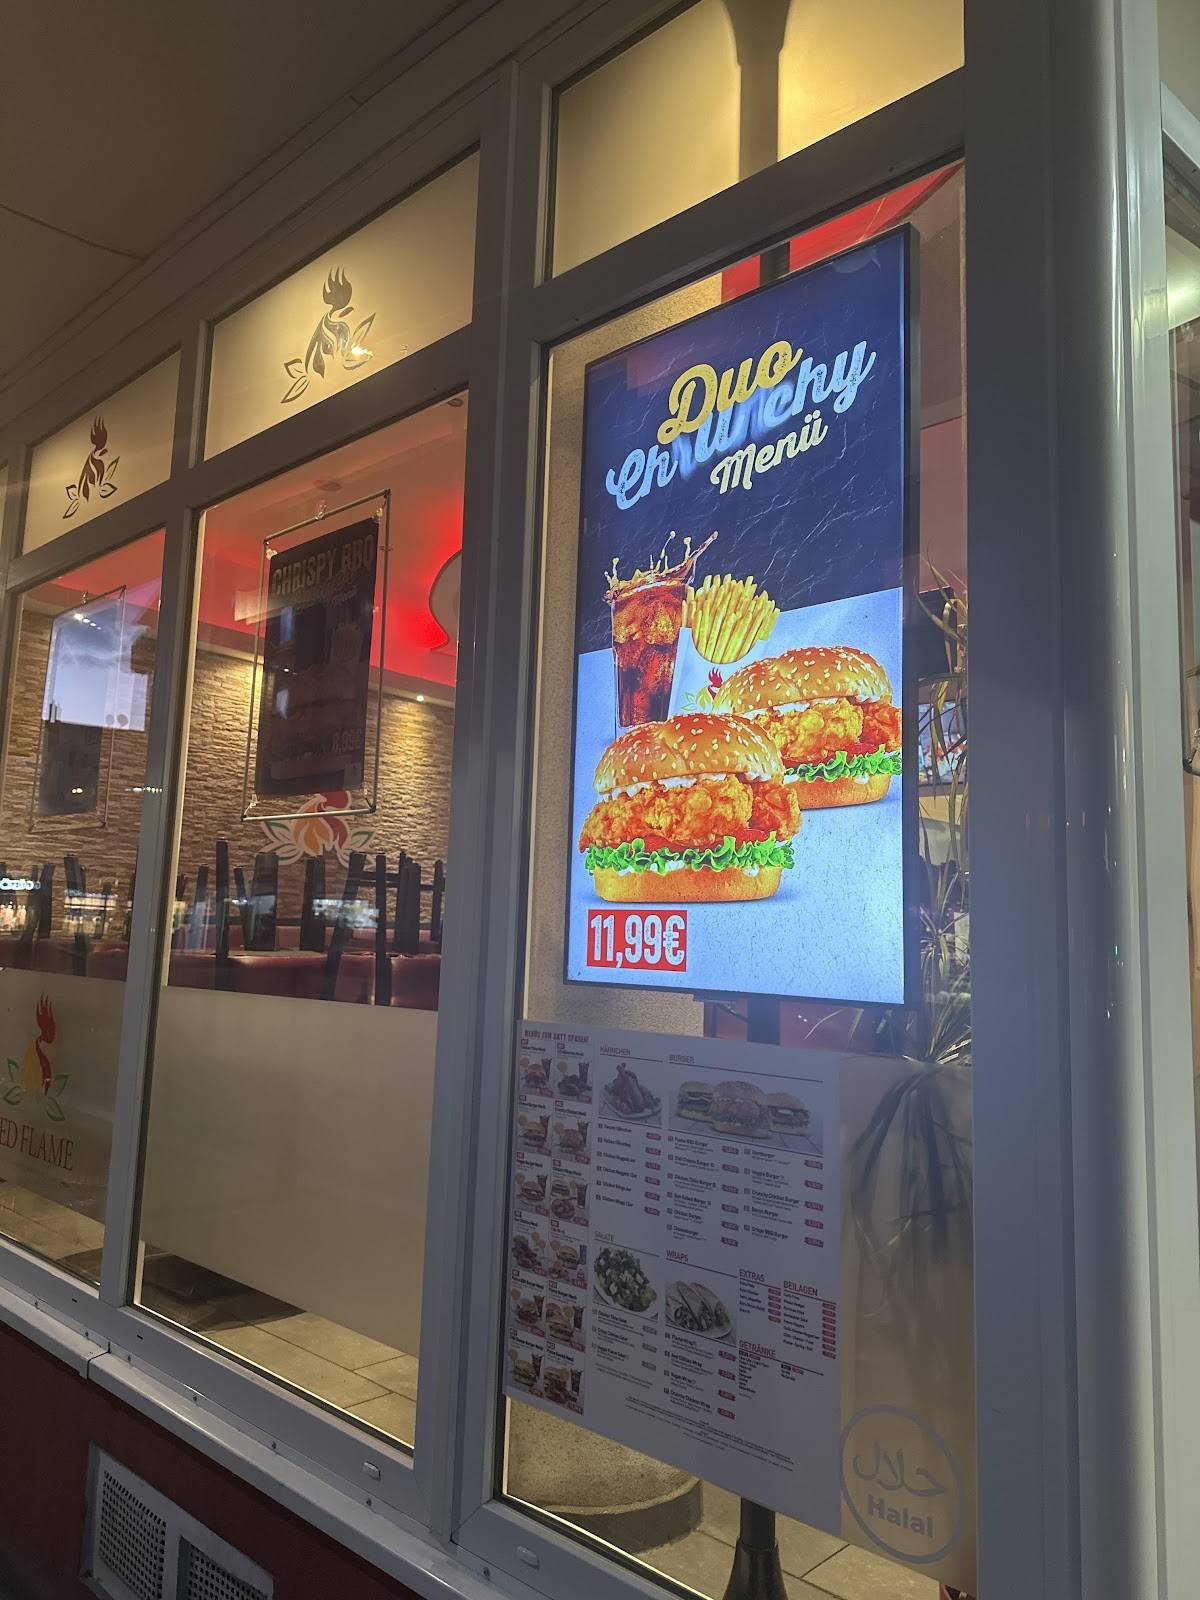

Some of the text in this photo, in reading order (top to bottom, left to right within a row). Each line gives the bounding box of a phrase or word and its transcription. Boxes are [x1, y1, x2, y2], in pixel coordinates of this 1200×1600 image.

[657, 340, 803, 445] Duo
[709, 410, 828, 495] Menü
[341, 535, 374, 571] BBQ
[589, 914, 686, 968] 11,99€
[669, 1053, 695, 1064] BURGER
[0, 1116, 73, 1171] ED FLAME
[666, 1249, 689, 1263] WRAPS
[739, 1268, 765, 1283] EXTRAS
[783, 1279, 818, 1297] BEILAGEN
[738, 1339, 776, 1358] GETRÄNKE
[852, 1439, 945, 1498] حلال
[867, 1493, 934, 1540] Halal
